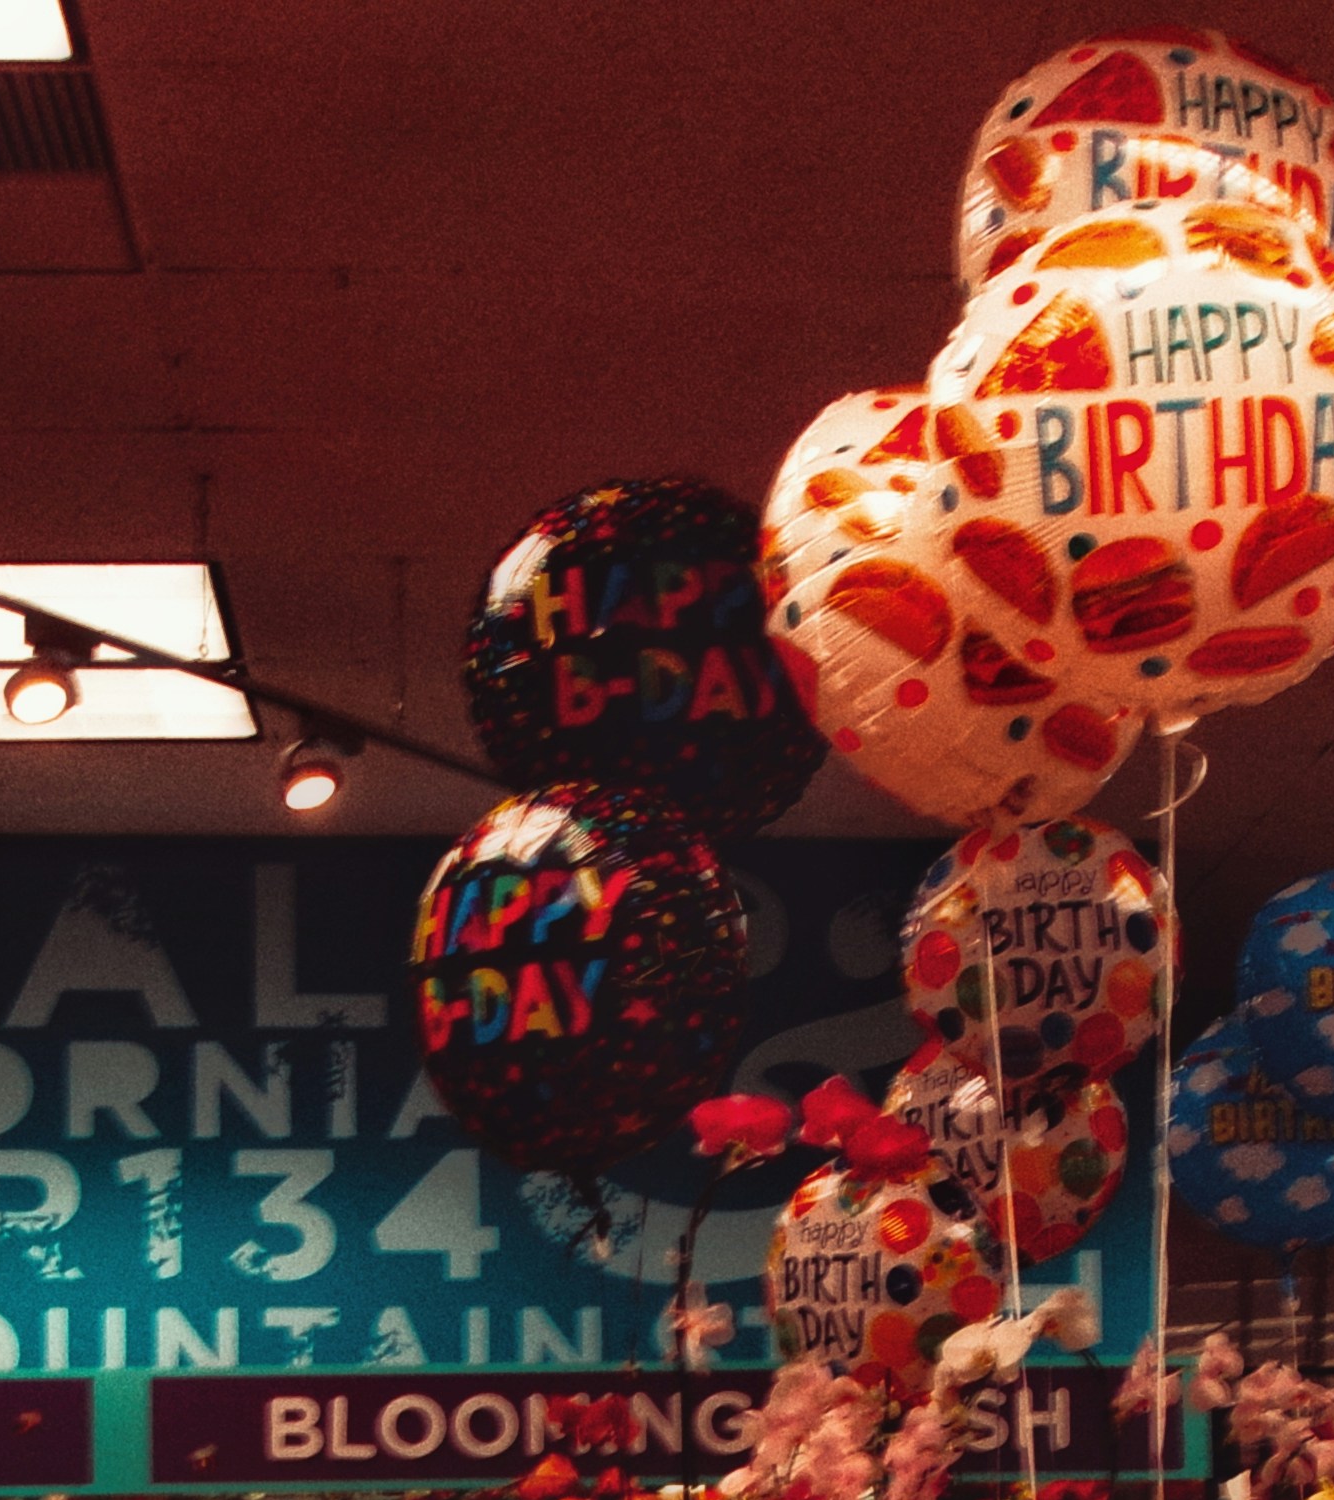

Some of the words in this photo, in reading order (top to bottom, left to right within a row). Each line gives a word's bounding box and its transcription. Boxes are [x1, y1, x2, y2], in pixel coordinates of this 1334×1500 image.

[1176, 71, 1324, 163] HAPPY
[1124, 300, 1300, 386] HAPPY
[533, 560, 755, 648] HAPP
[412, 866, 635, 964] HAPPY
[982, 901, 1121, 954] BIRTH
[1007, 956, 1103, 1010] DAY
[801, 1216, 867, 1251] happy
[783, 1252, 883, 1304] BIRTH
[798, 1307, 865, 1360] DAY
[269, 1391, 754, 1463] BLOONG
